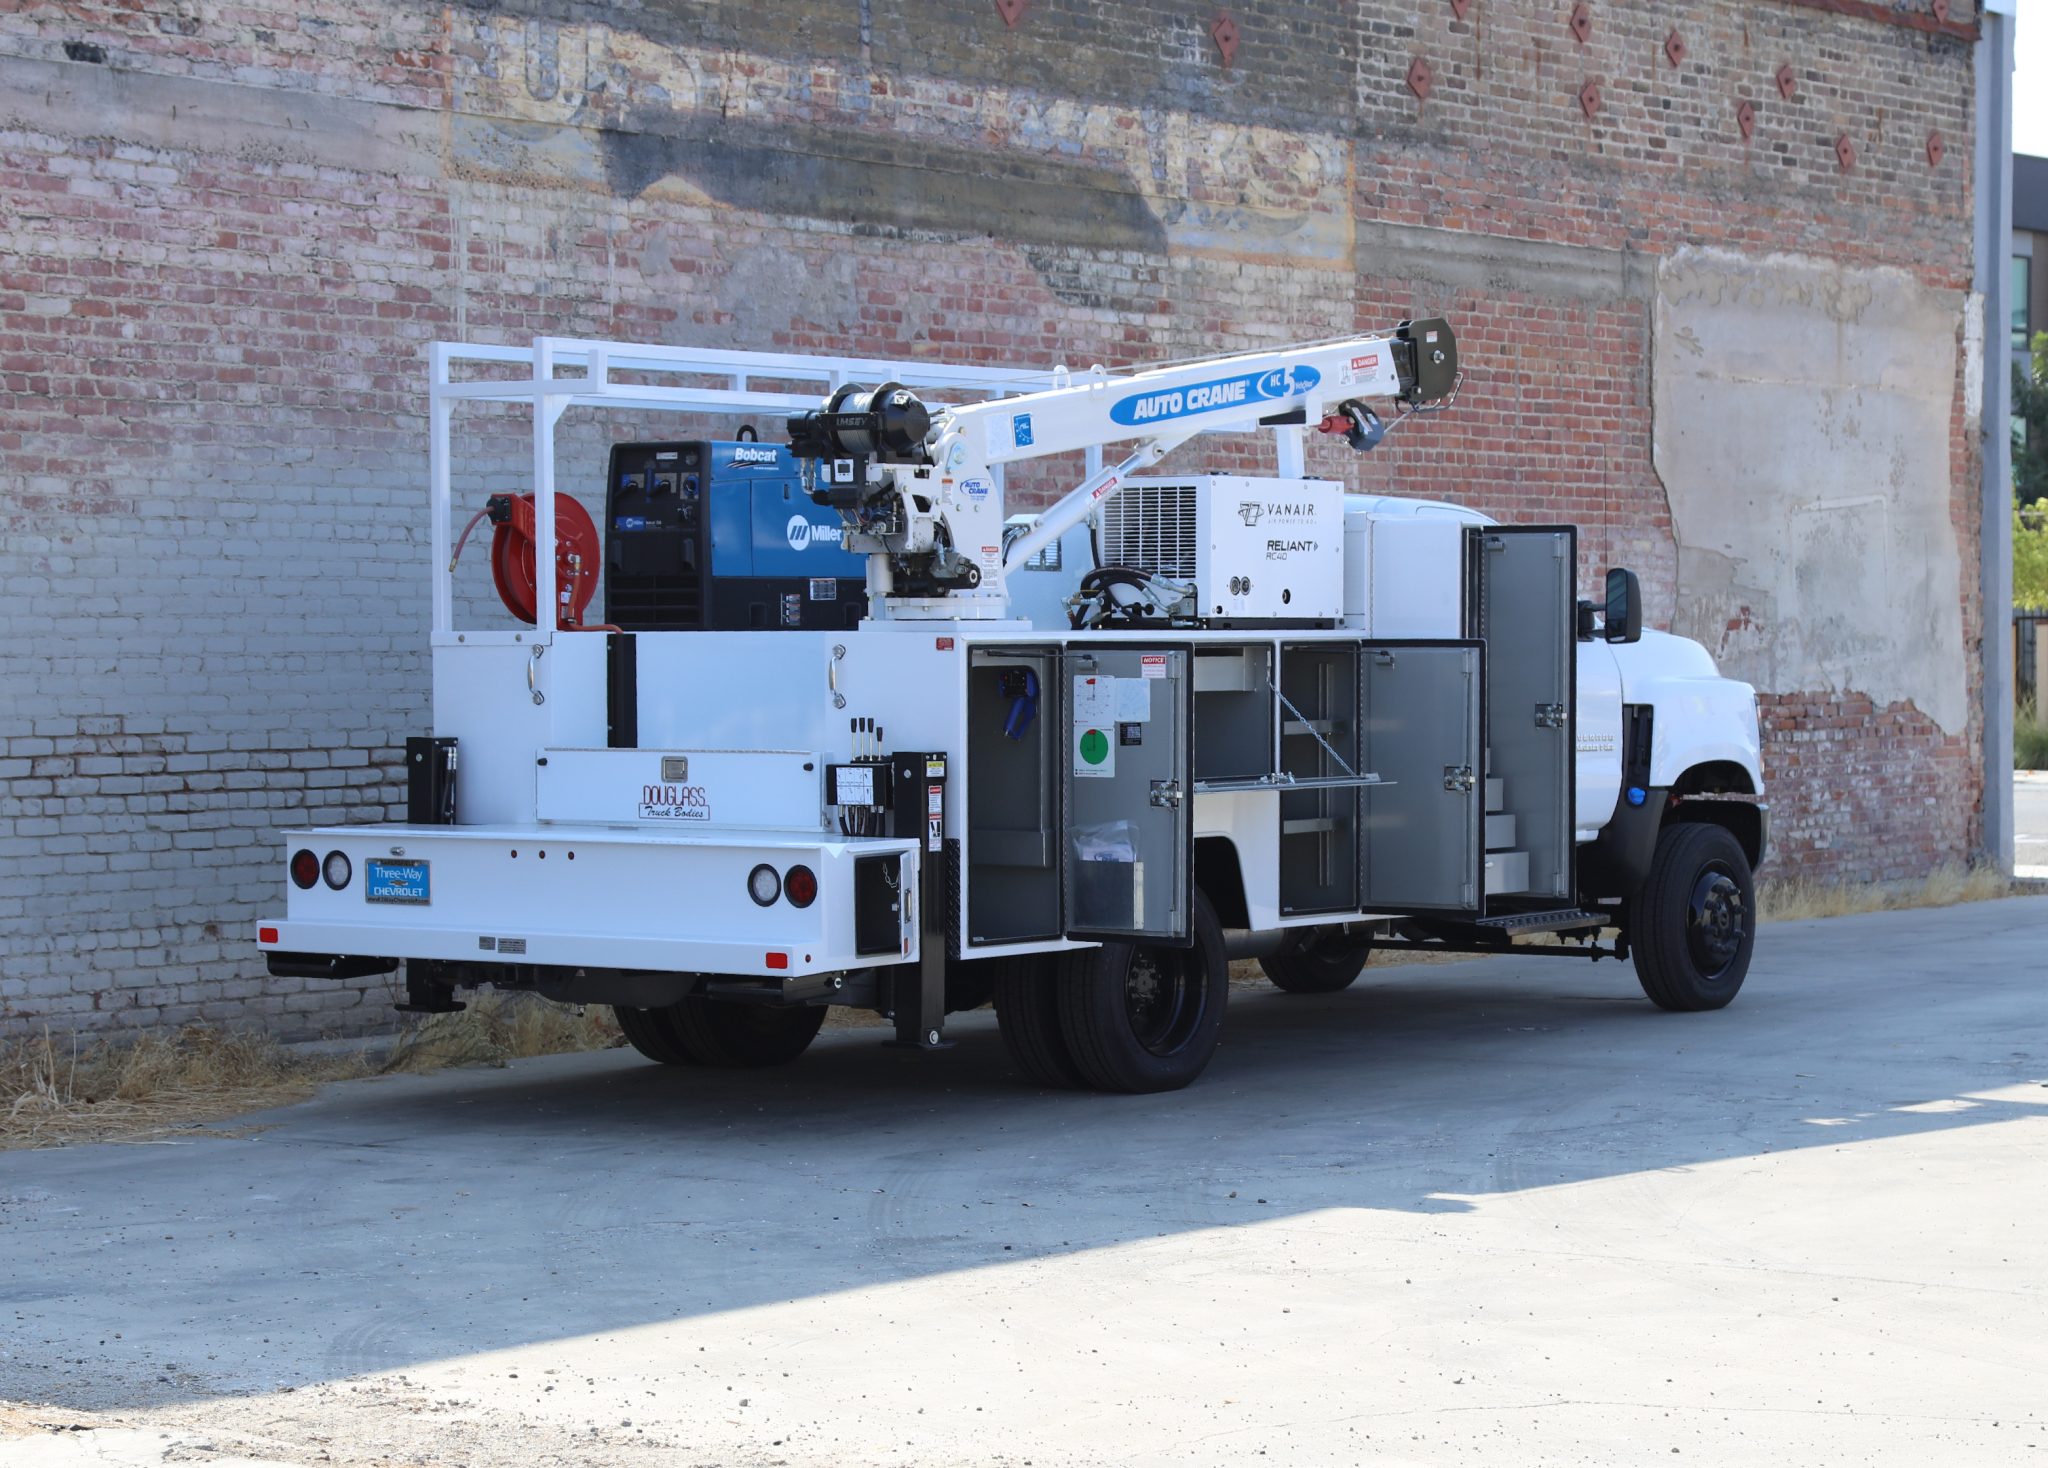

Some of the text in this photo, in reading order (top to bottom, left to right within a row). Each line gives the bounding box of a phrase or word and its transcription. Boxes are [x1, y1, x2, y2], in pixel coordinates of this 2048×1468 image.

[1270, 373, 1281, 388] HC
[1283, 365, 1296, 397] 5
[1133, 380, 1247, 420] AUTO CRANE
[734, 447, 777, 462] Bobcat
[1267, 503, 1314, 516] VANAIR
[811, 525, 842, 541] Miller
[1267, 540, 1313, 551] RELIANT
[1265, 552, 1288, 561] RC40
[643, 785, 706, 807] DOUGLASS
[645, 805, 704, 818] Truck Bodies
[374, 867, 423, 881] Three-Way
[373, 886, 424, 897] CHEVROLET
